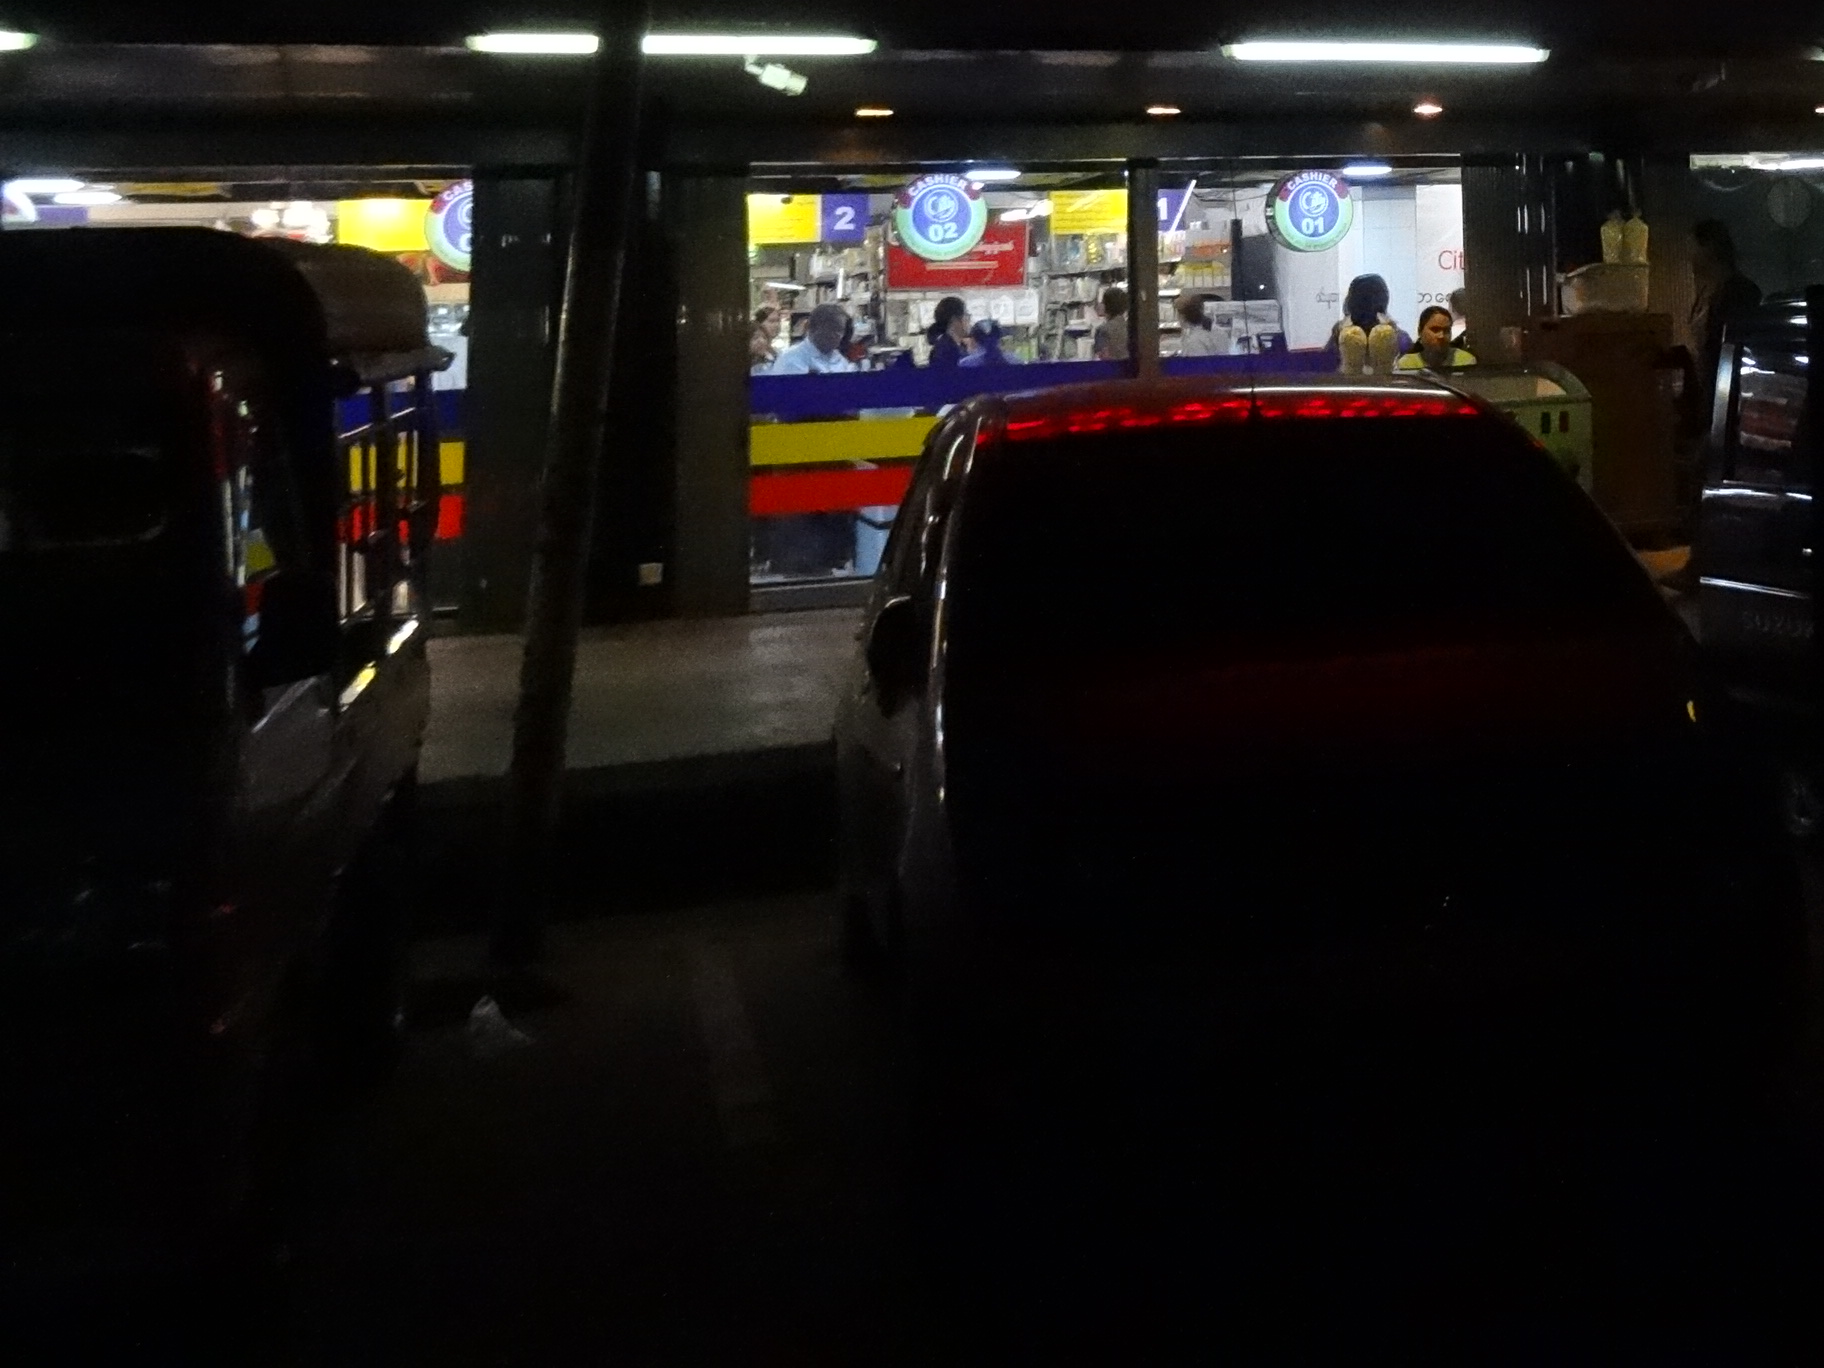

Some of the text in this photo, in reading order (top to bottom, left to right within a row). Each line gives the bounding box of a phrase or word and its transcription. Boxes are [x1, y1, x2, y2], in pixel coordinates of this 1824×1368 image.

[1287, 172, 1338, 190] CASHIER
[1157, 197, 1168, 220] 1
[833, 206, 856, 231] 2
[1301, 218, 1325, 235] 01
[928, 223, 958, 242] 02
